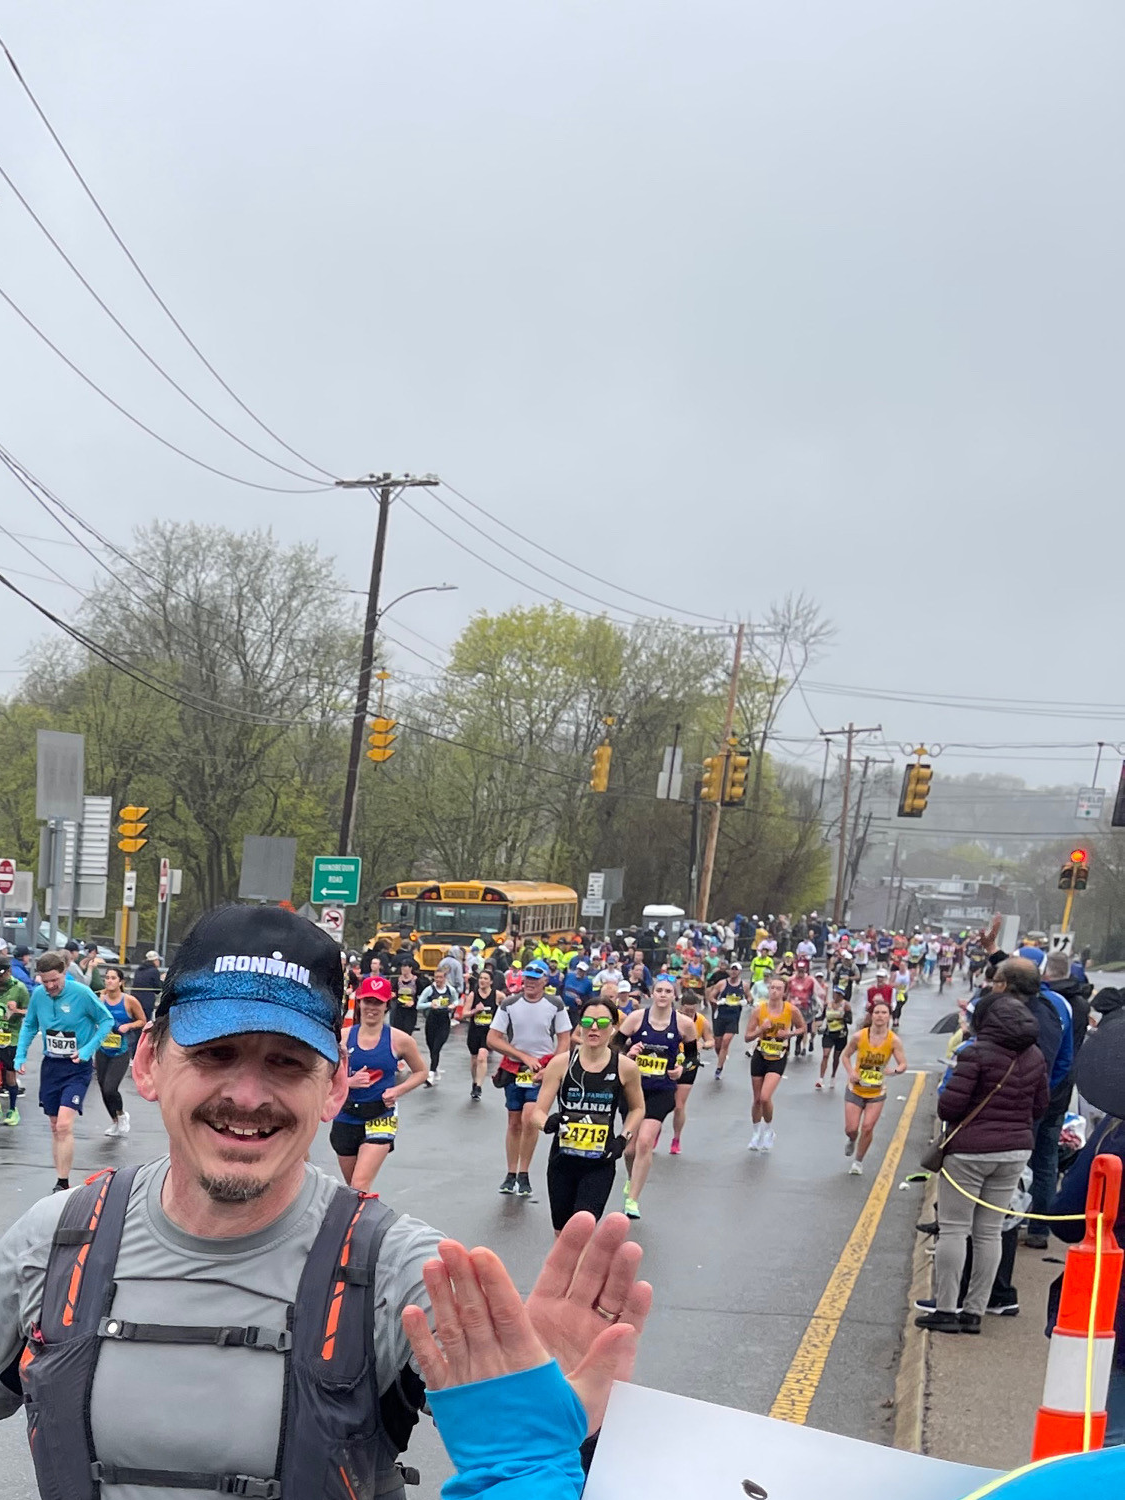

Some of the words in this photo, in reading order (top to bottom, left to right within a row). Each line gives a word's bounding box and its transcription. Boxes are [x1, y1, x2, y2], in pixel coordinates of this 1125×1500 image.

[214, 951, 311, 988] IRONMAN
[47, 1038, 76, 1049] 15878
[566, 1101, 612, 1112] AMANDA
[560, 1126, 607, 1143] 24713
